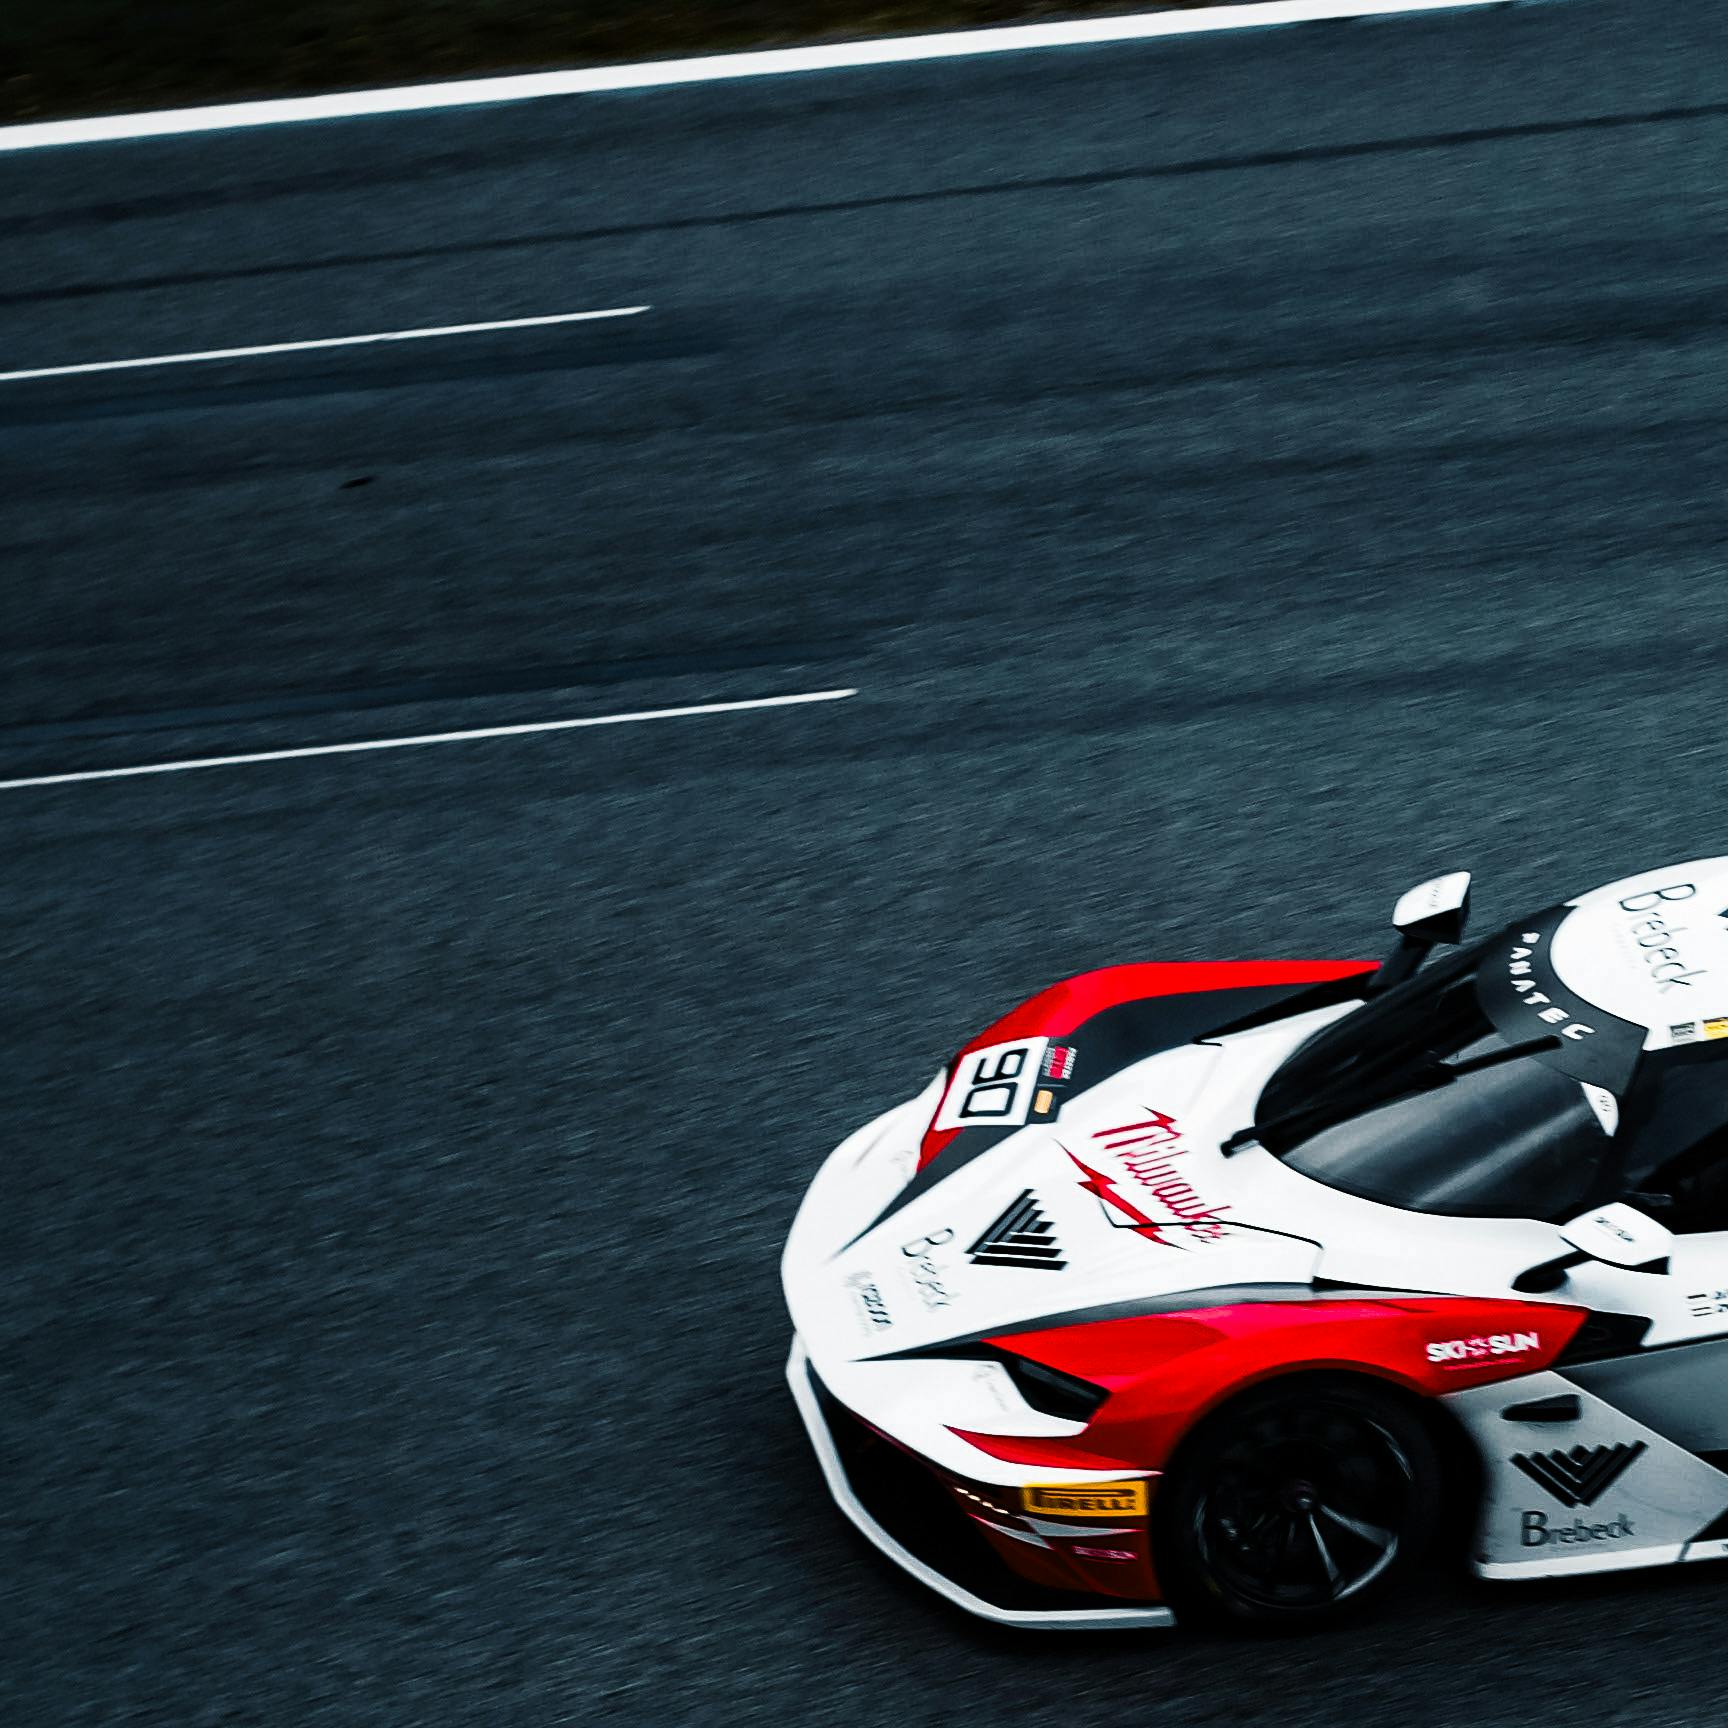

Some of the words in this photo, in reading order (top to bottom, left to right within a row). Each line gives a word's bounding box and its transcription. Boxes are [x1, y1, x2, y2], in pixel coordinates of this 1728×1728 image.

[1509, 932, 1595, 1041] FANATEC
[959, 1048, 1029, 1118] 90
[1488, 1332, 1540, 1354] SUN
[1033, 1487, 1137, 1511] PIRELLI
[1519, 1510, 1635, 1547] Brebeck
